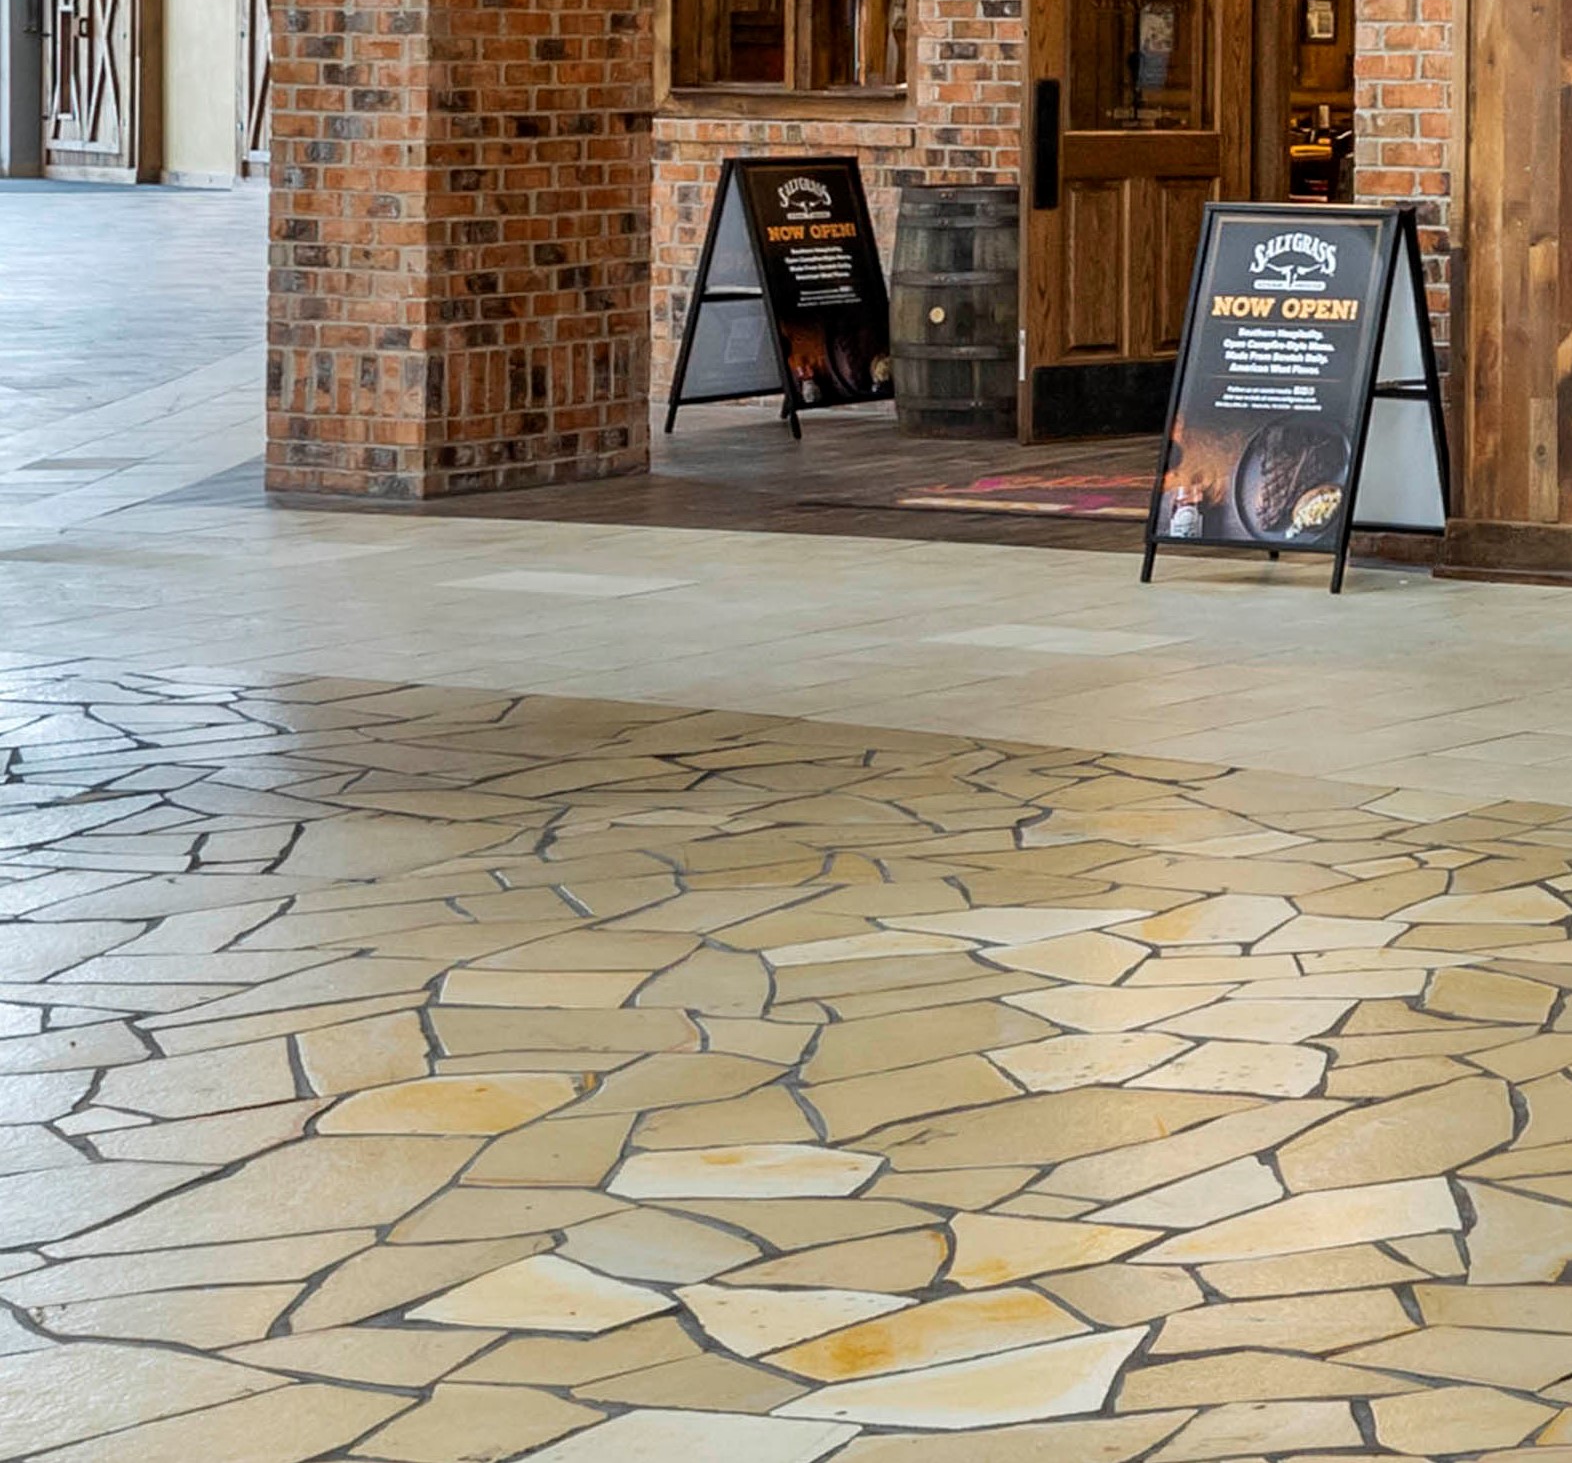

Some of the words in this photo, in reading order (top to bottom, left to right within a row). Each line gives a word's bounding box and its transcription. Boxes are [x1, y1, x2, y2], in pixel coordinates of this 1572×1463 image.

[767, 225, 804, 242] NOW
[1248, 232, 1337, 275] SALTGRASS
[1211, 295, 1276, 318] NOW
[1281, 297, 1359, 320] OPEN!
